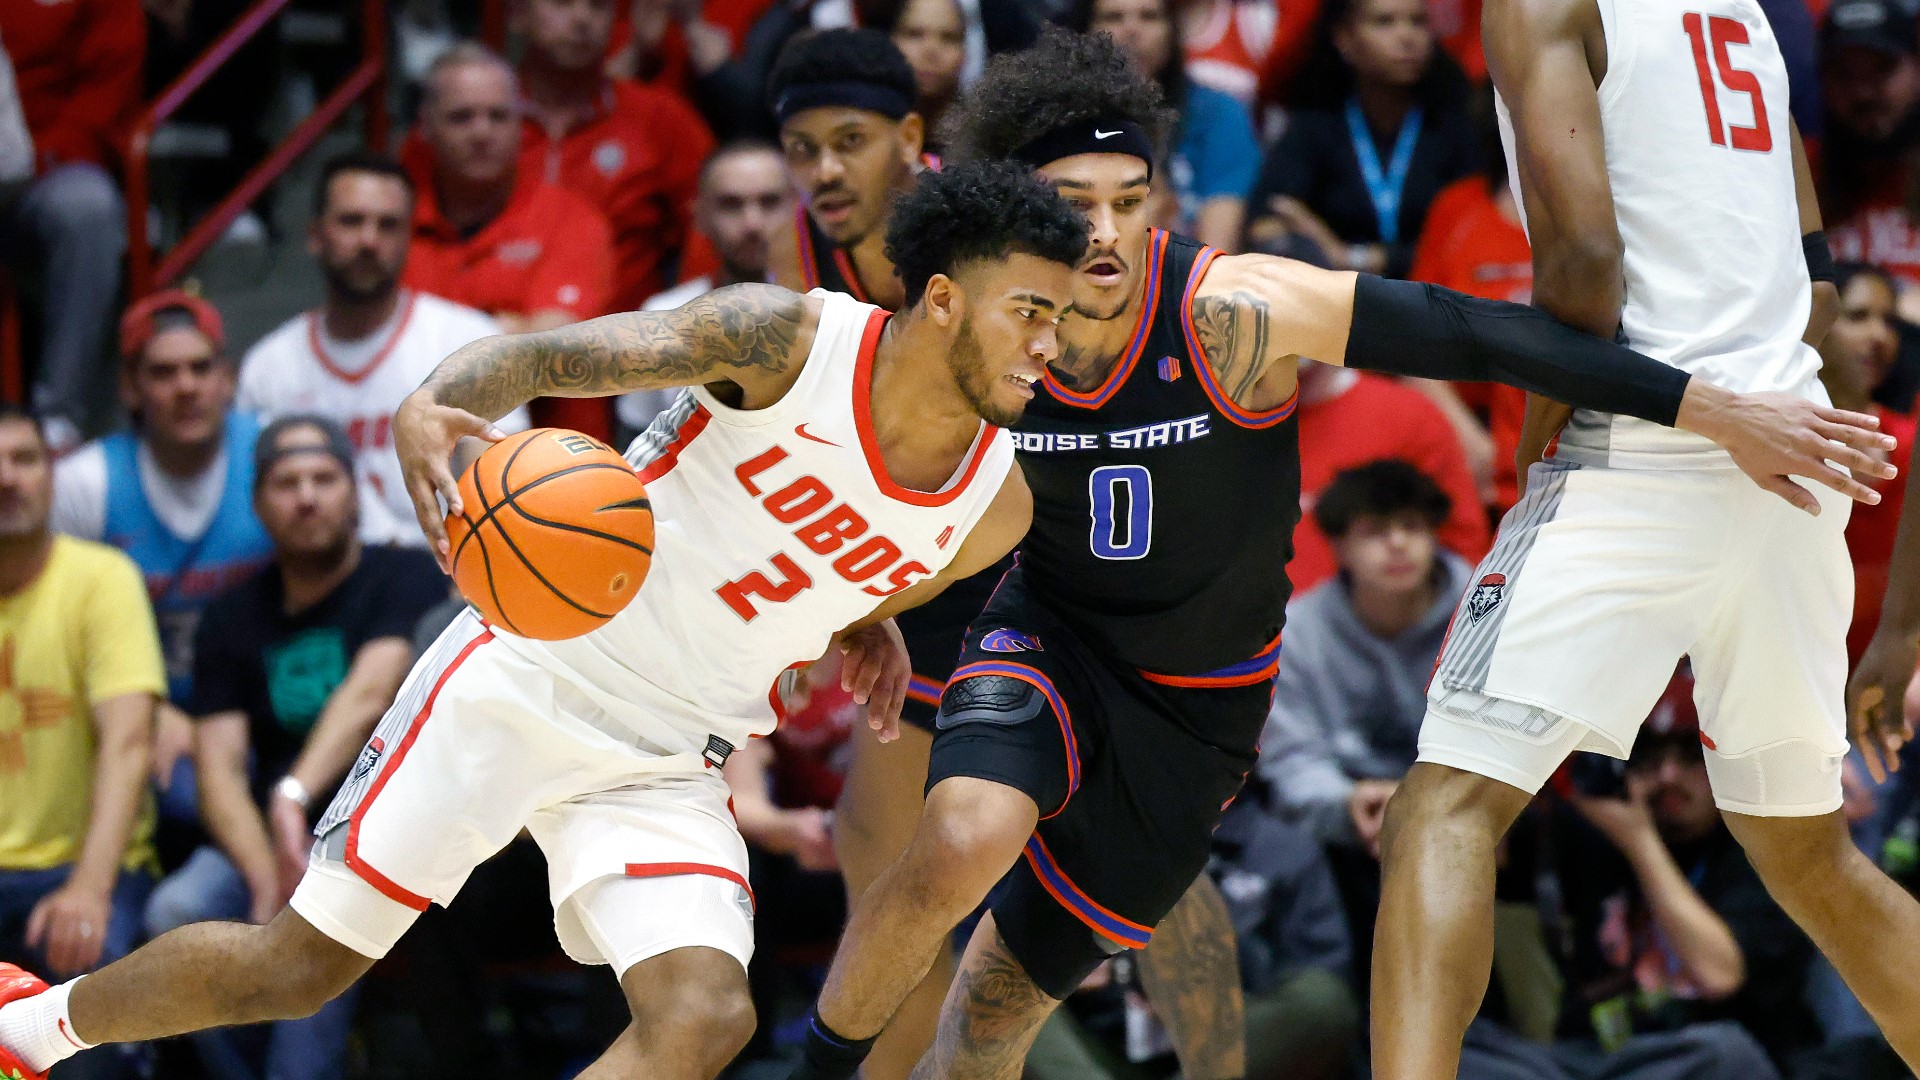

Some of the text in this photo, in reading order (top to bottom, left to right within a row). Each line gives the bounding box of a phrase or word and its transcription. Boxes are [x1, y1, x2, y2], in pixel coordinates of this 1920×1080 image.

[1681, 11, 1773, 154] 15
[1010, 412, 1210, 451] BOISE STATE
[734, 443, 932, 597] LOBOS
[1089, 464, 1153, 560] 0
[712, 549, 815, 625] 2
